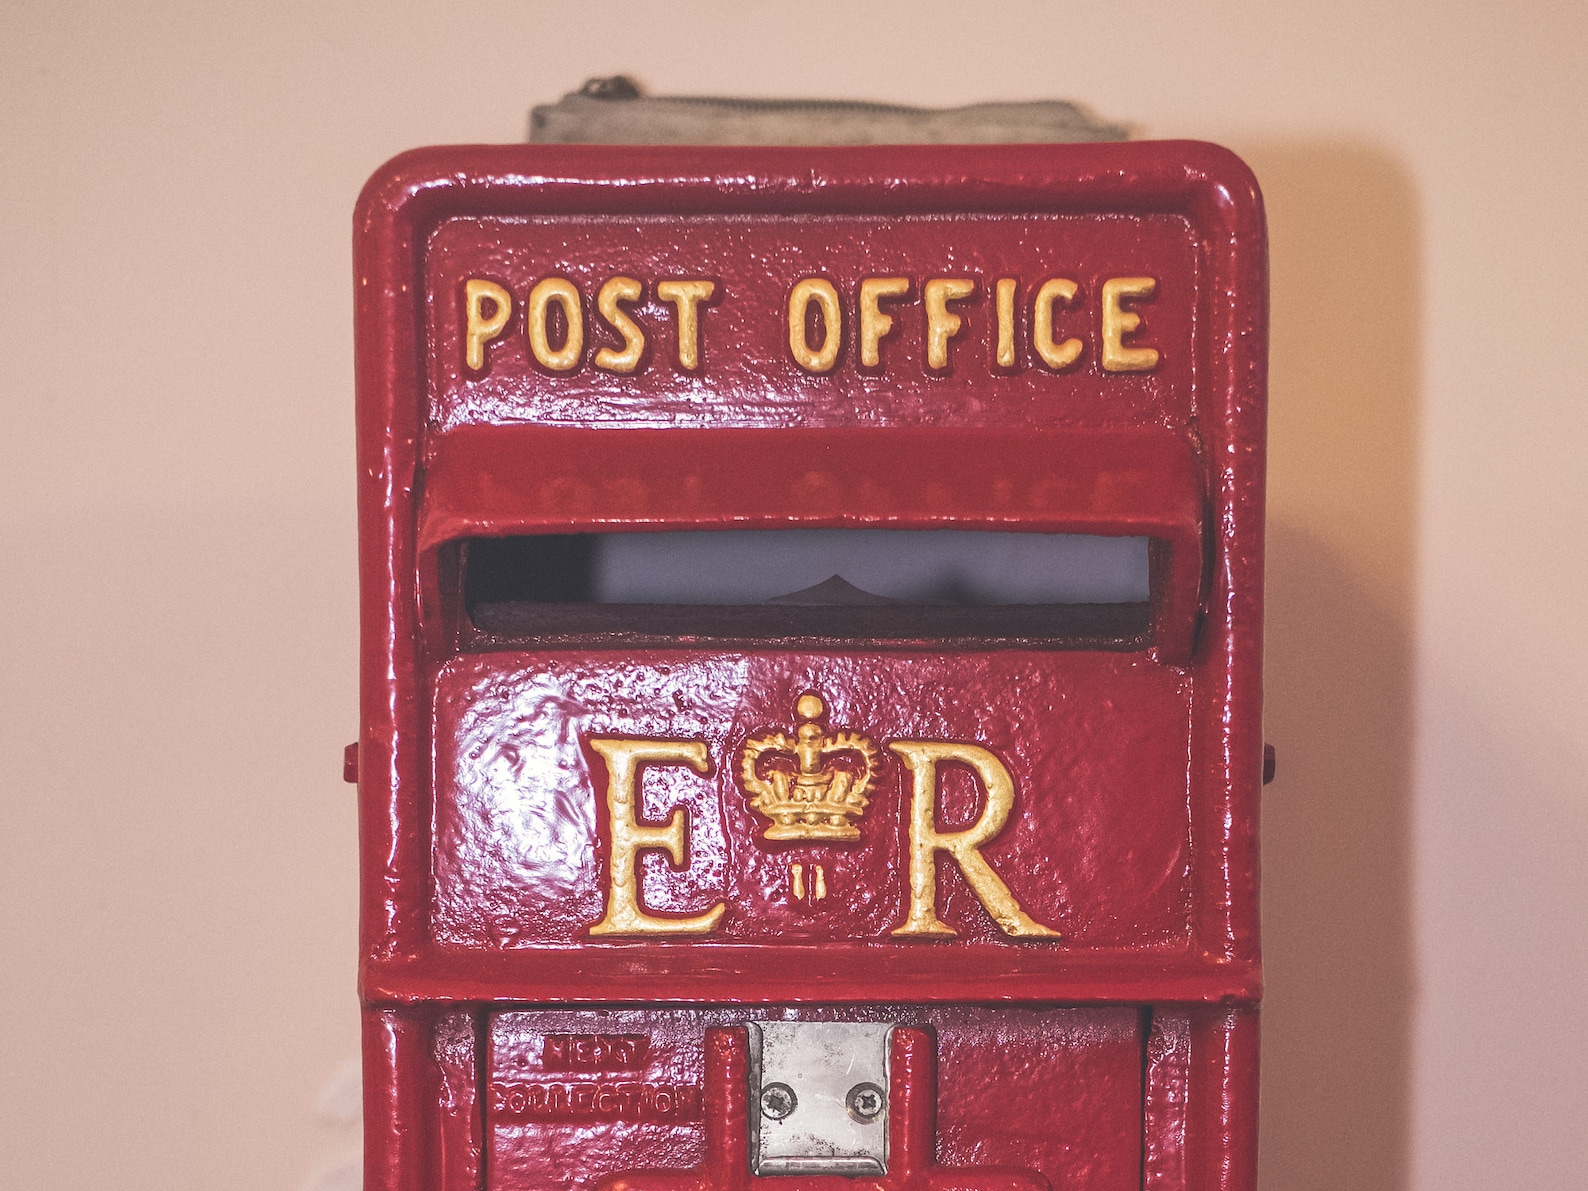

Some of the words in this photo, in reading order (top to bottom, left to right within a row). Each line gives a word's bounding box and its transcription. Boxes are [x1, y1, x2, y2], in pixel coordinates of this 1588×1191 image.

[466, 278, 714, 370] POST
[789, 278, 1158, 370] OFFICE
[590, 740, 724, 934] E
[890, 742, 1059, 936] R
